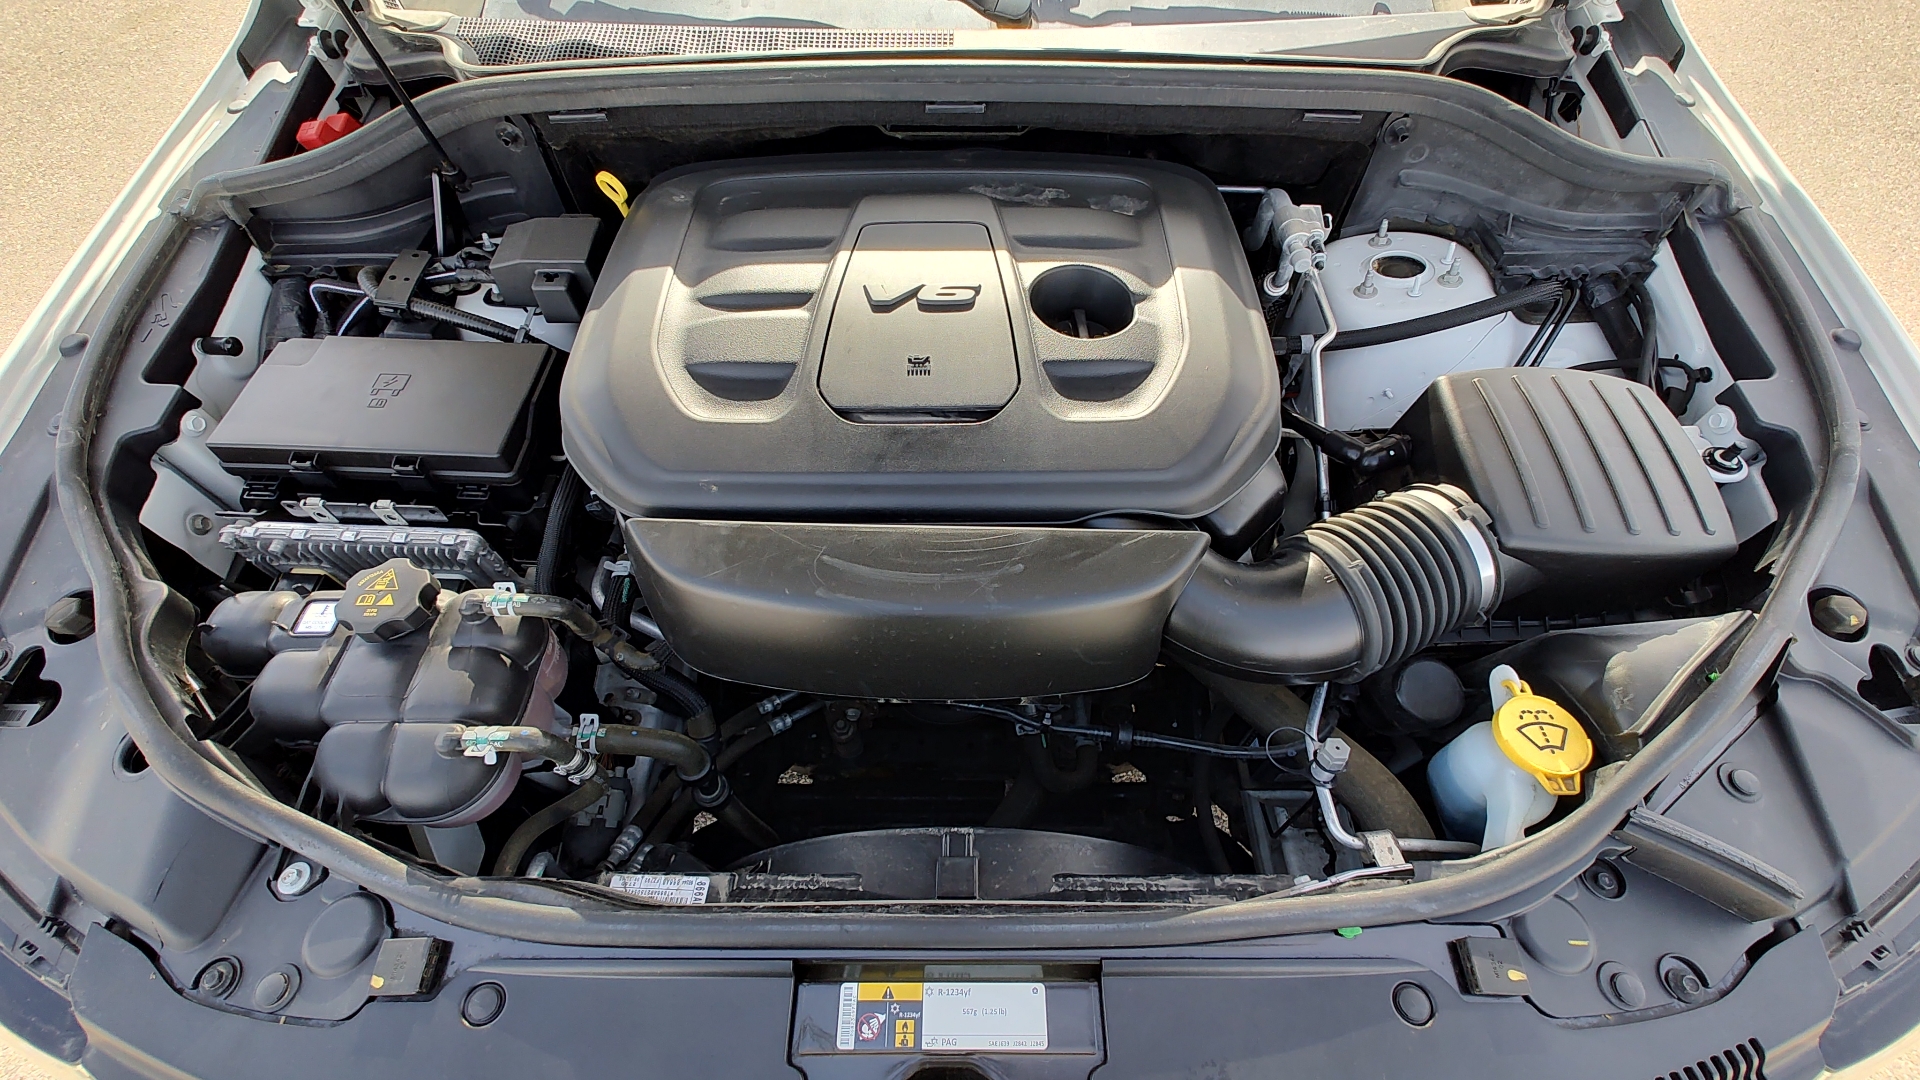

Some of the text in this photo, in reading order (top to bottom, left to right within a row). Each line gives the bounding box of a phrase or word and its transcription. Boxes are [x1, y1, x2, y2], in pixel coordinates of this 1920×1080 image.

[863, 283, 982, 311] V6
[938, 987, 972, 999] R-1234yf
[962, 1008, 978, 1017] 567g
[941, 1037, 958, 1047] PAG
